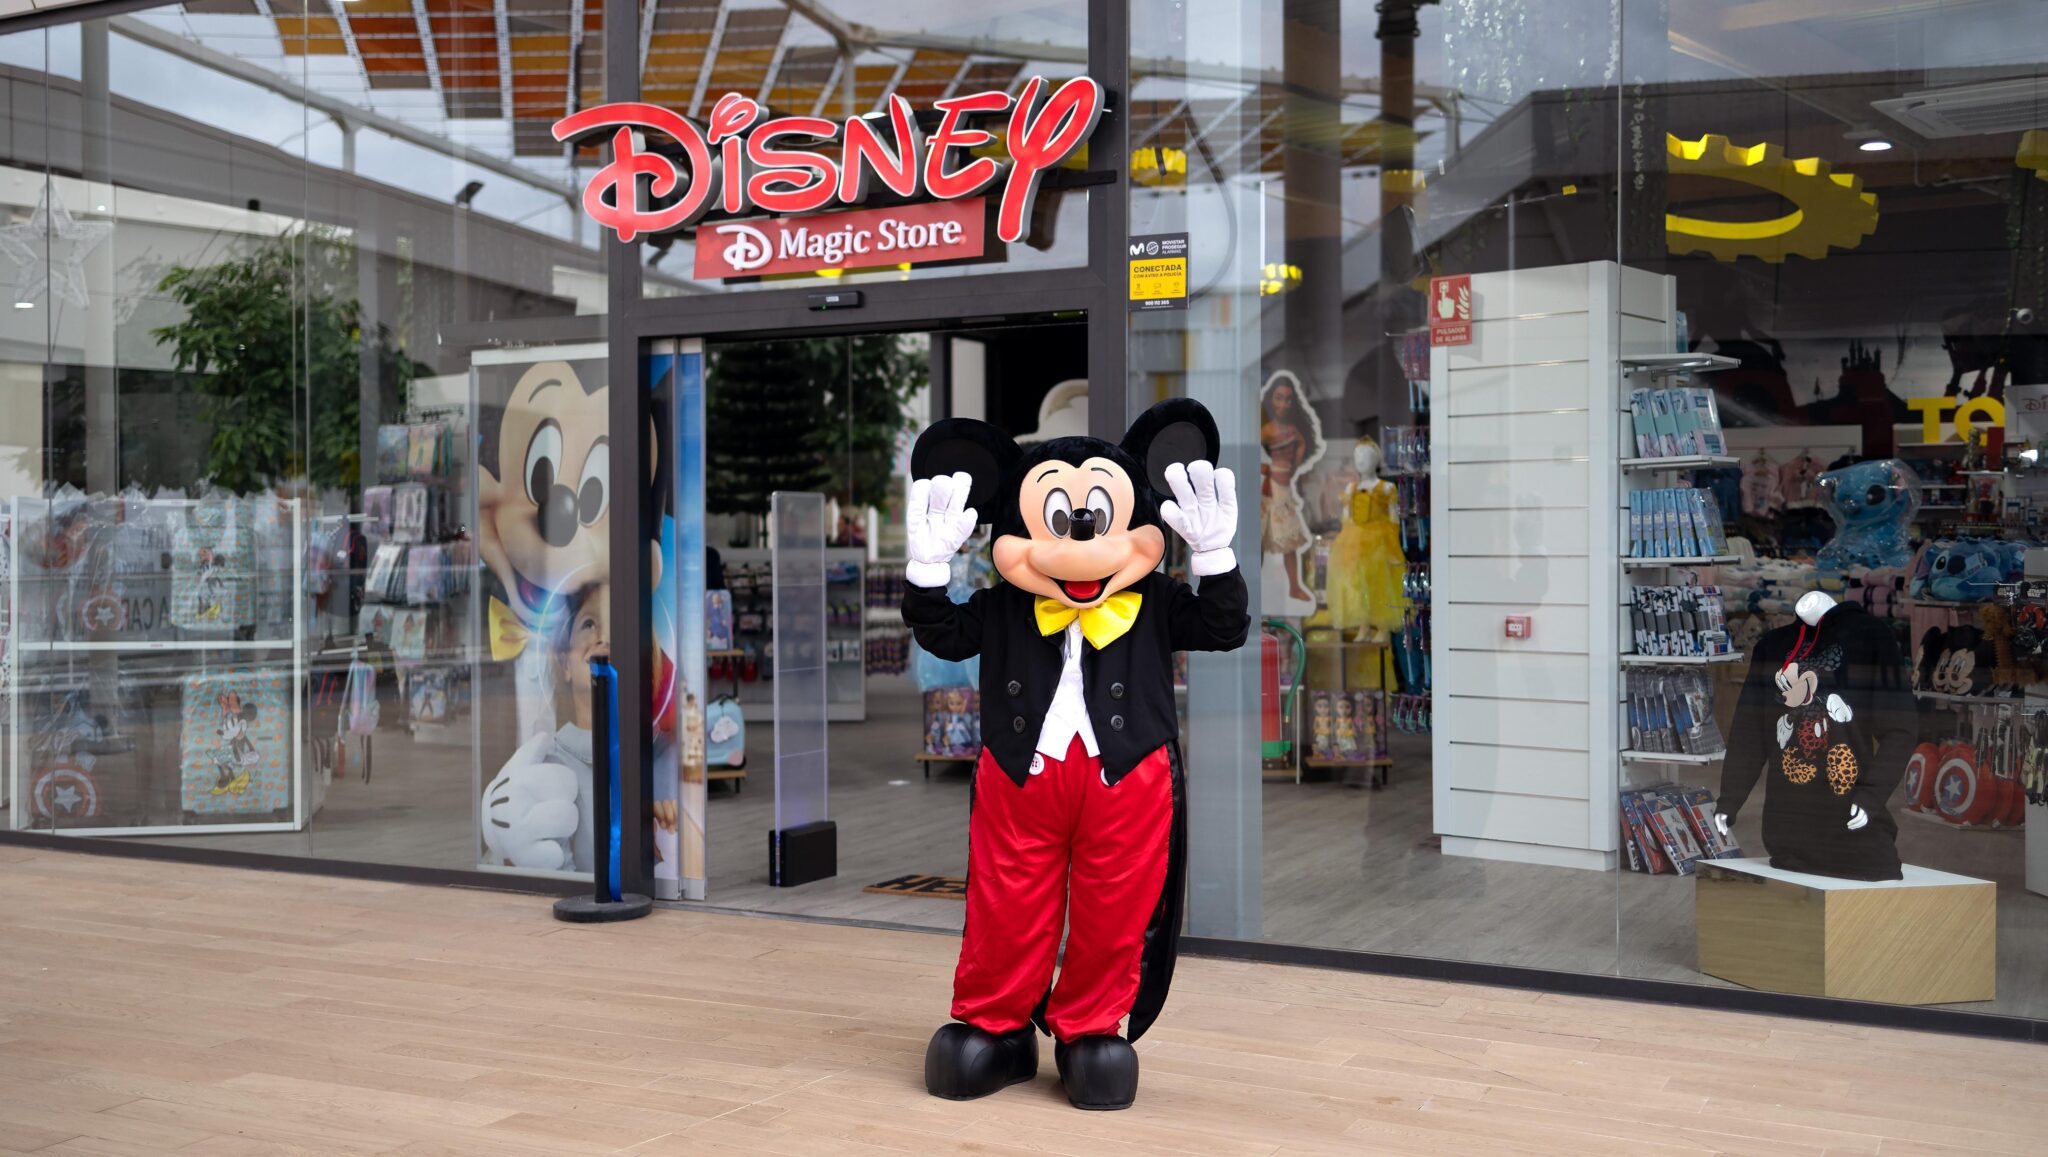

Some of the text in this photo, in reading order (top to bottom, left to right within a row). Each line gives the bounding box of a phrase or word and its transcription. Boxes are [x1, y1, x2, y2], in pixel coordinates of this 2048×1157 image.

[778, 225, 872, 265] Magic
[877, 219, 964, 252] Store
[1133, 264, 1182, 273] CONECTADA
[1436, 326, 1466, 335] PULSADOR
[1435, 333, 1467, 343] DE ALARMA
